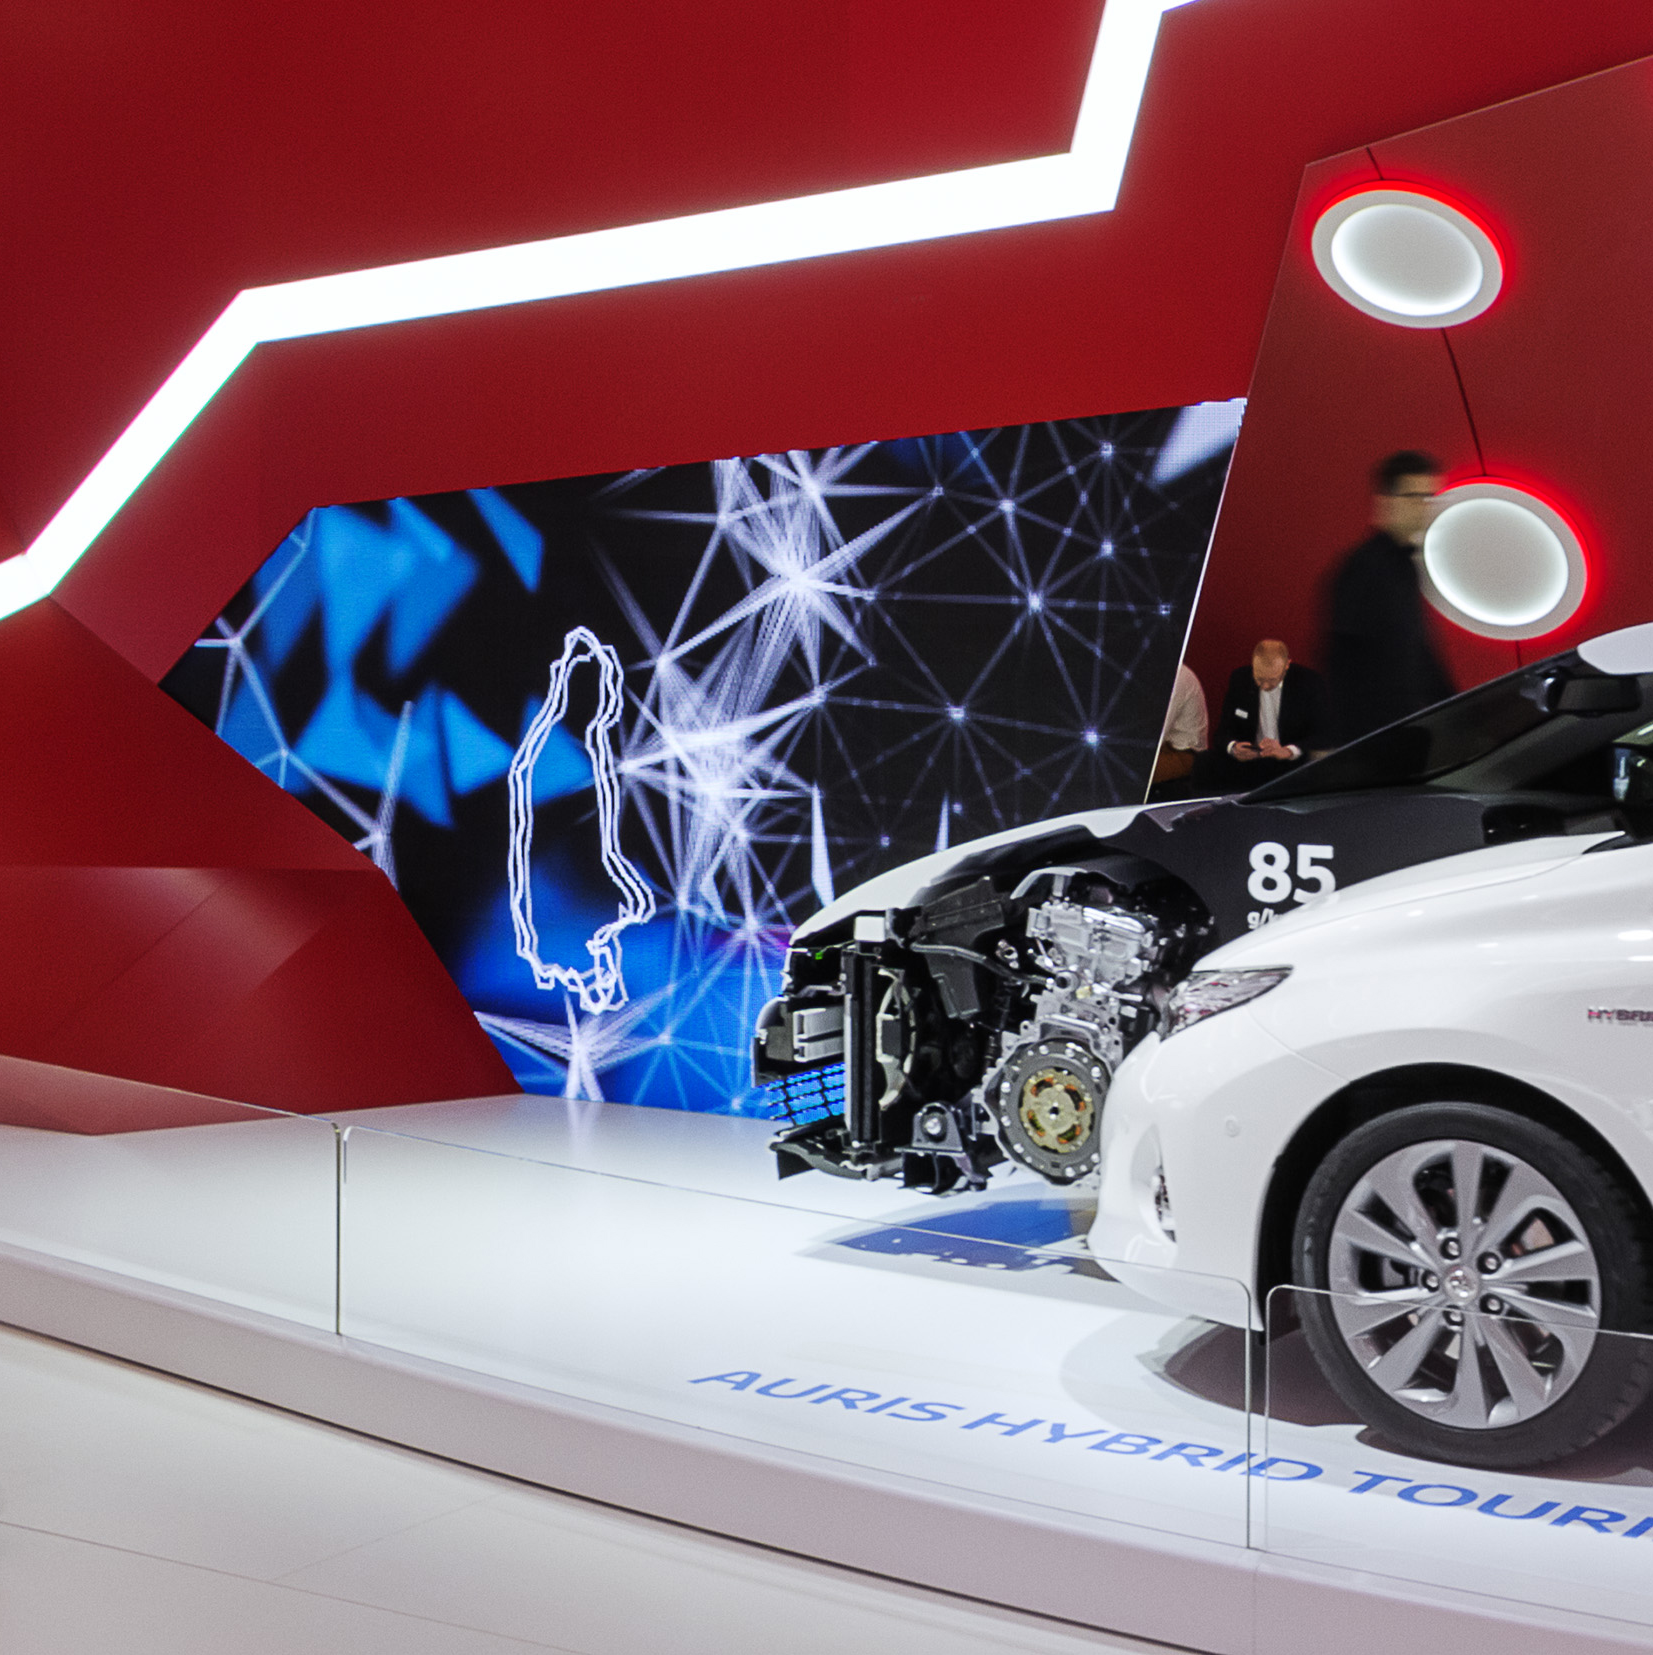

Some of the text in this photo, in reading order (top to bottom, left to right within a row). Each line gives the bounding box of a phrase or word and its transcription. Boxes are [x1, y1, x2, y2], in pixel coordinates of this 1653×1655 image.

[1247, 841, 1336, 905] 85
[688, 1370, 967, 1423] AURIS
[960, 1411, 1325, 1483] HYBRID
